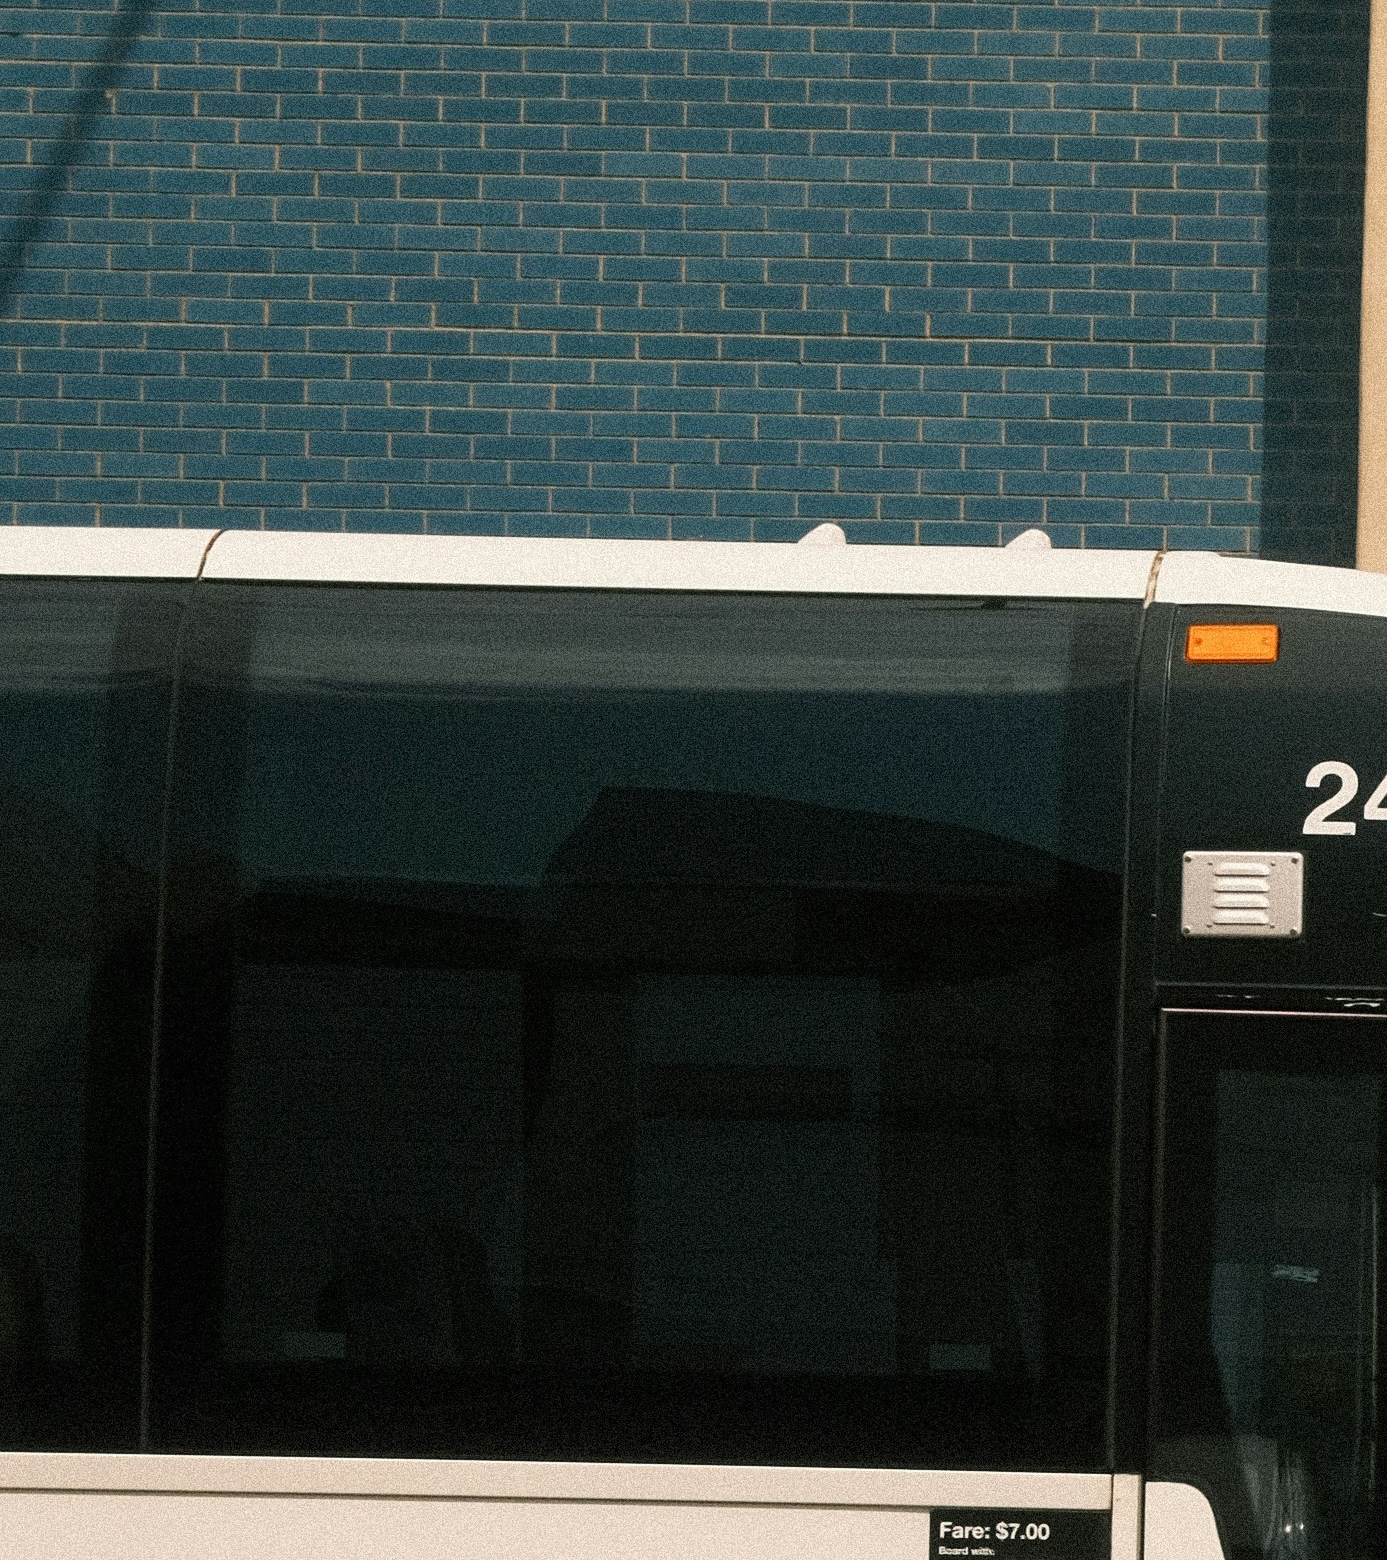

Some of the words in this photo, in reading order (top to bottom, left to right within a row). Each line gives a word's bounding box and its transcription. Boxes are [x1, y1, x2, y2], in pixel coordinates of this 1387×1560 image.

[939, 1522, 990, 1540] Fare:
[995, 1521, 1050, 1541] $7.00
[938, 1546, 969, 1555] Board
